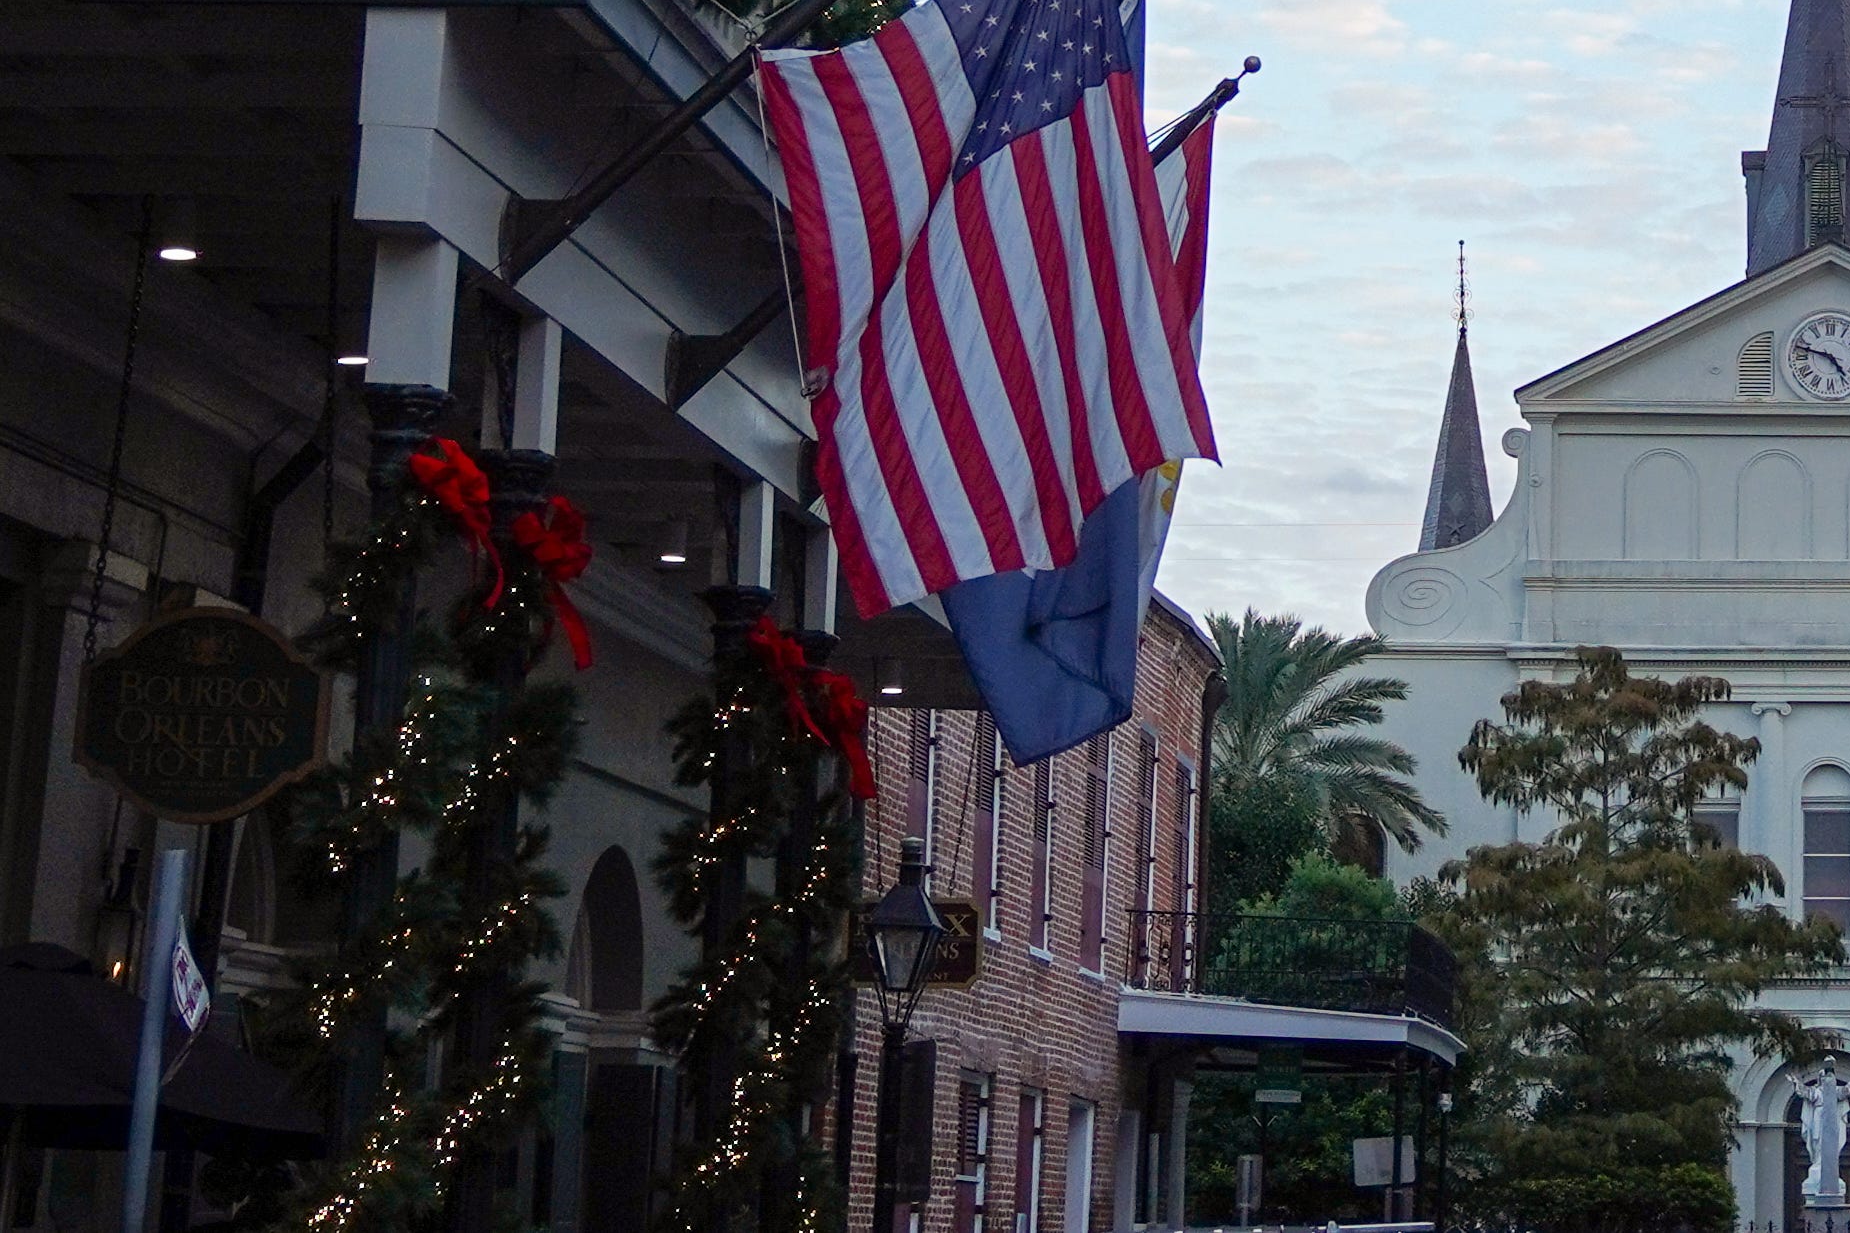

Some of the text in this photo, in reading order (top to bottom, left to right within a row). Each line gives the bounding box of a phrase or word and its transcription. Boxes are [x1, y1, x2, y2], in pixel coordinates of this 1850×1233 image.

[119, 670, 291, 709] BOURBON
[114, 706, 287, 749] ORLEANS
[127, 747, 266, 779] HOTEL
